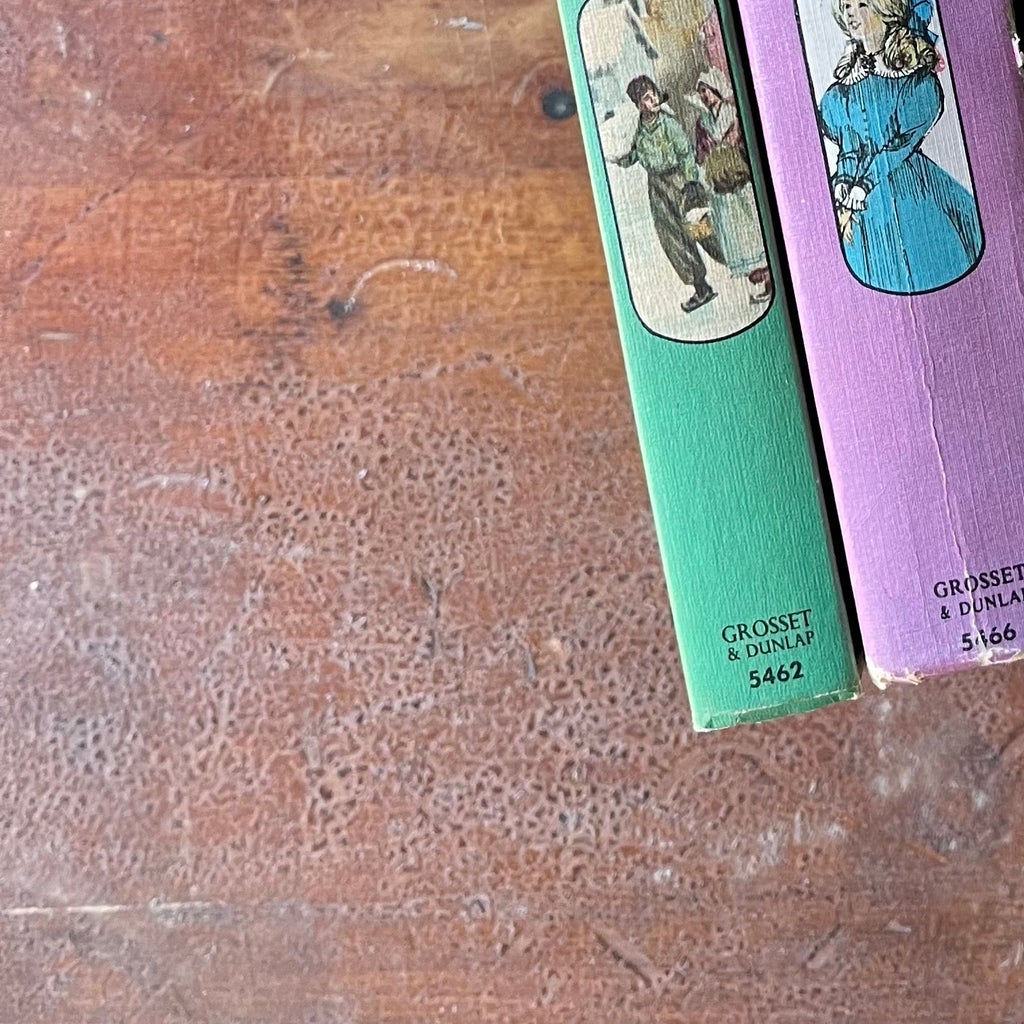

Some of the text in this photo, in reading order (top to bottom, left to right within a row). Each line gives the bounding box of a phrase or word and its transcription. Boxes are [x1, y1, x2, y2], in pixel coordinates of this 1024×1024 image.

[934, 563, 1024, 598] GROSSET
[721, 609, 812, 644] GROSSET
[941, 605, 951, 619] &
[727, 631, 815, 662] & DUNLAP
[749, 661, 804, 688] 5462
